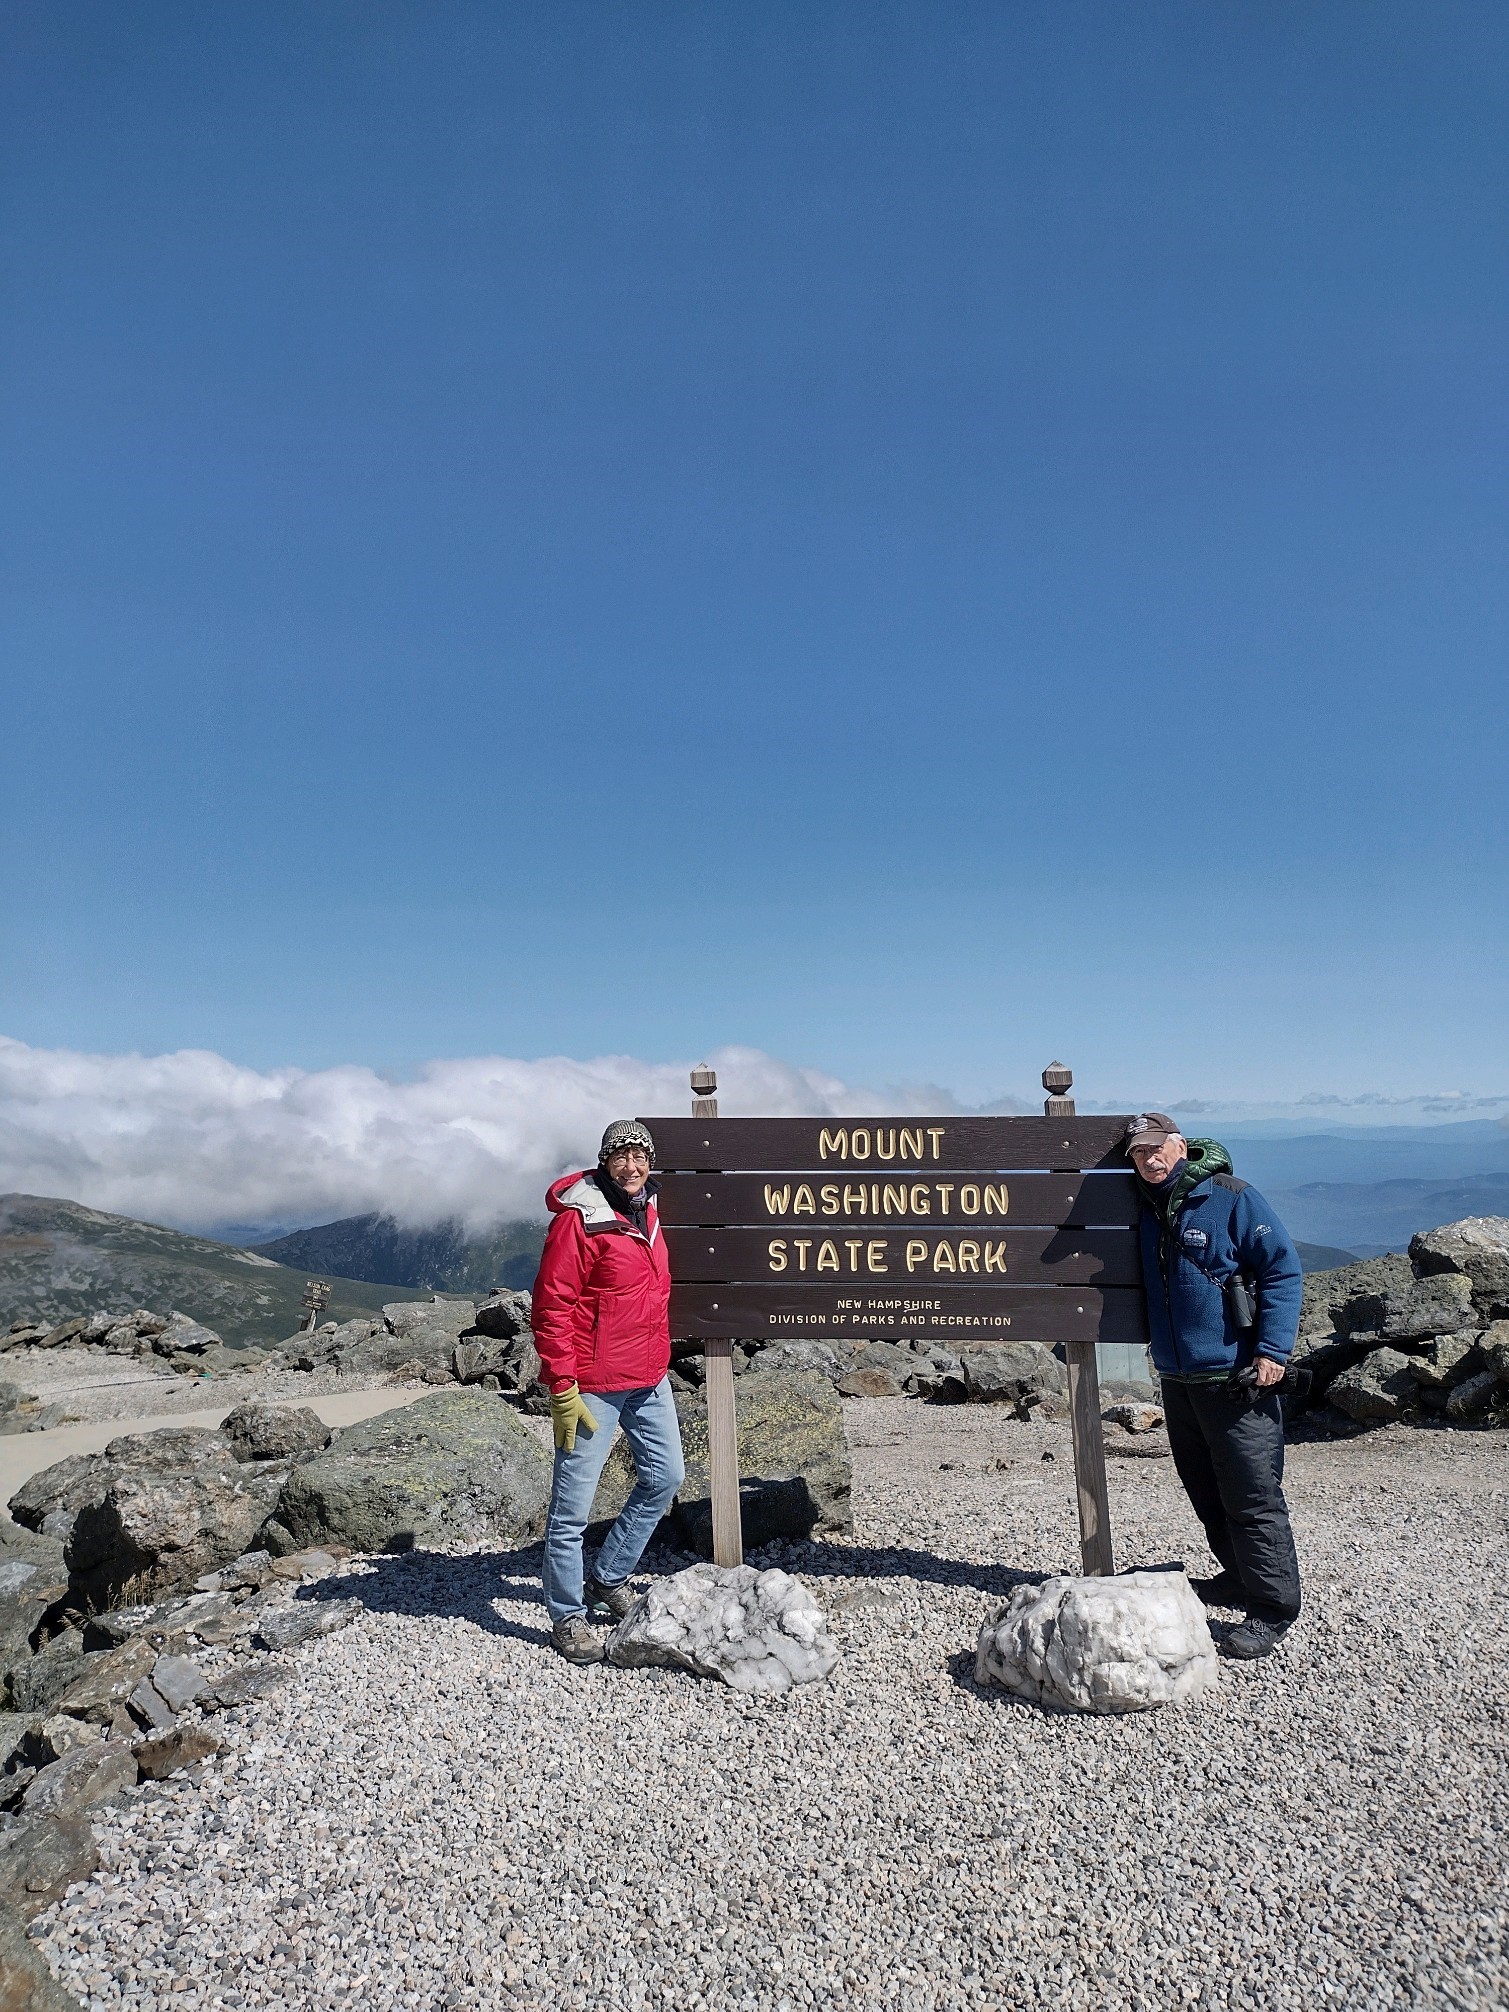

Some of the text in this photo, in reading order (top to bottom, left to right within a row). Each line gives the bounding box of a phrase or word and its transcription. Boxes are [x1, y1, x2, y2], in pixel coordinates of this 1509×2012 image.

[819, 1127, 946, 1160] MOUNT
[763, 1183, 1010, 1216] WASHINGTON
[768, 1239, 1008, 1274] STATE PARK
[769, 1314, 1012, 1326] DIVISION OF PARKS AND RECREATION
[837, 1299, 942, 1310] NEW HAMPSHIRE
